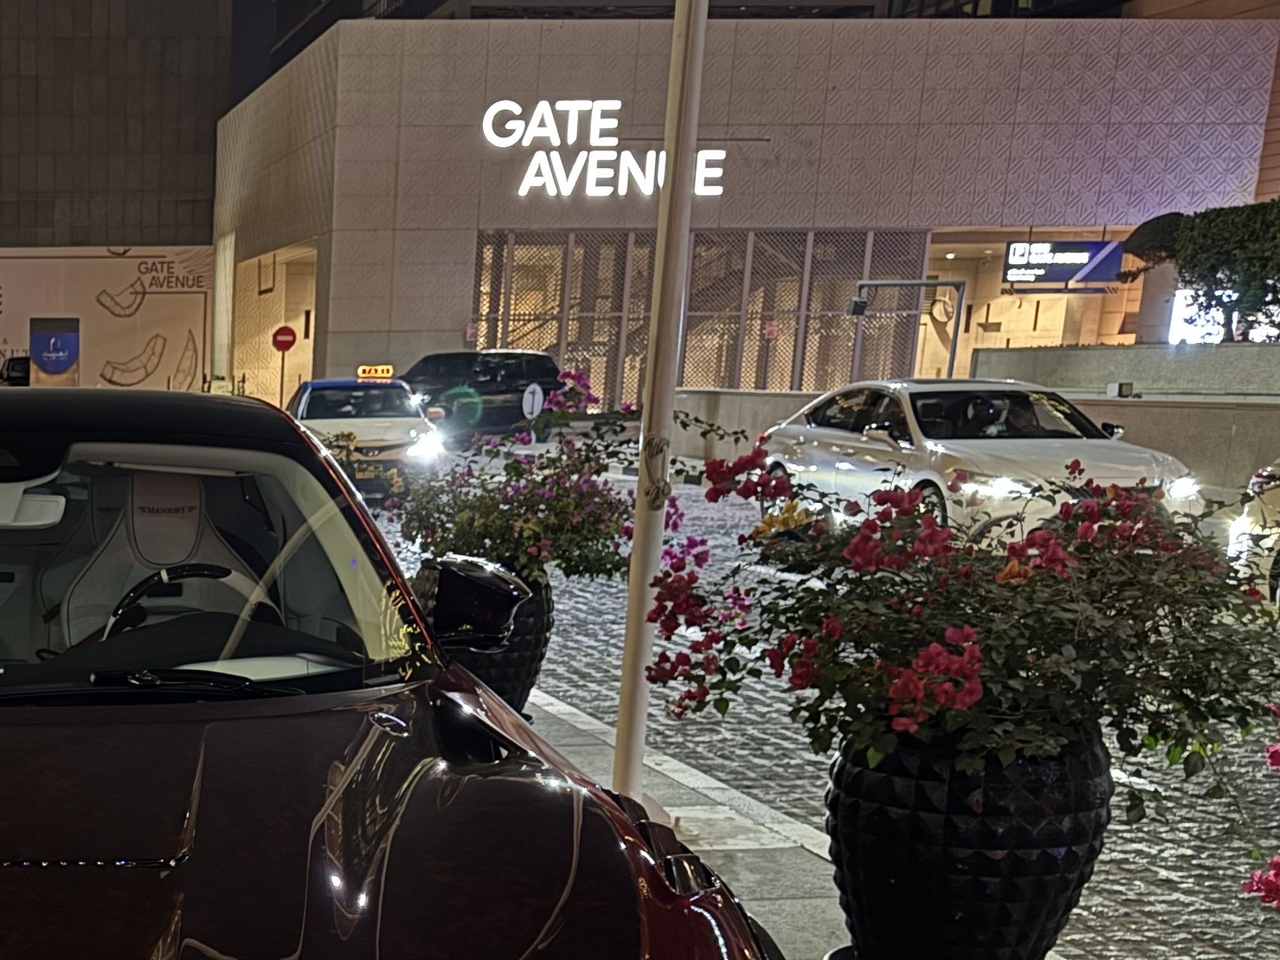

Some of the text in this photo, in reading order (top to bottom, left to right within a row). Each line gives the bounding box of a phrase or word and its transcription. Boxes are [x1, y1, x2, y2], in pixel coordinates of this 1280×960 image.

[482, 99, 622, 148] GATE
[137, 261, 175, 275] GATE
[148, 275, 205, 289] AVENUE
